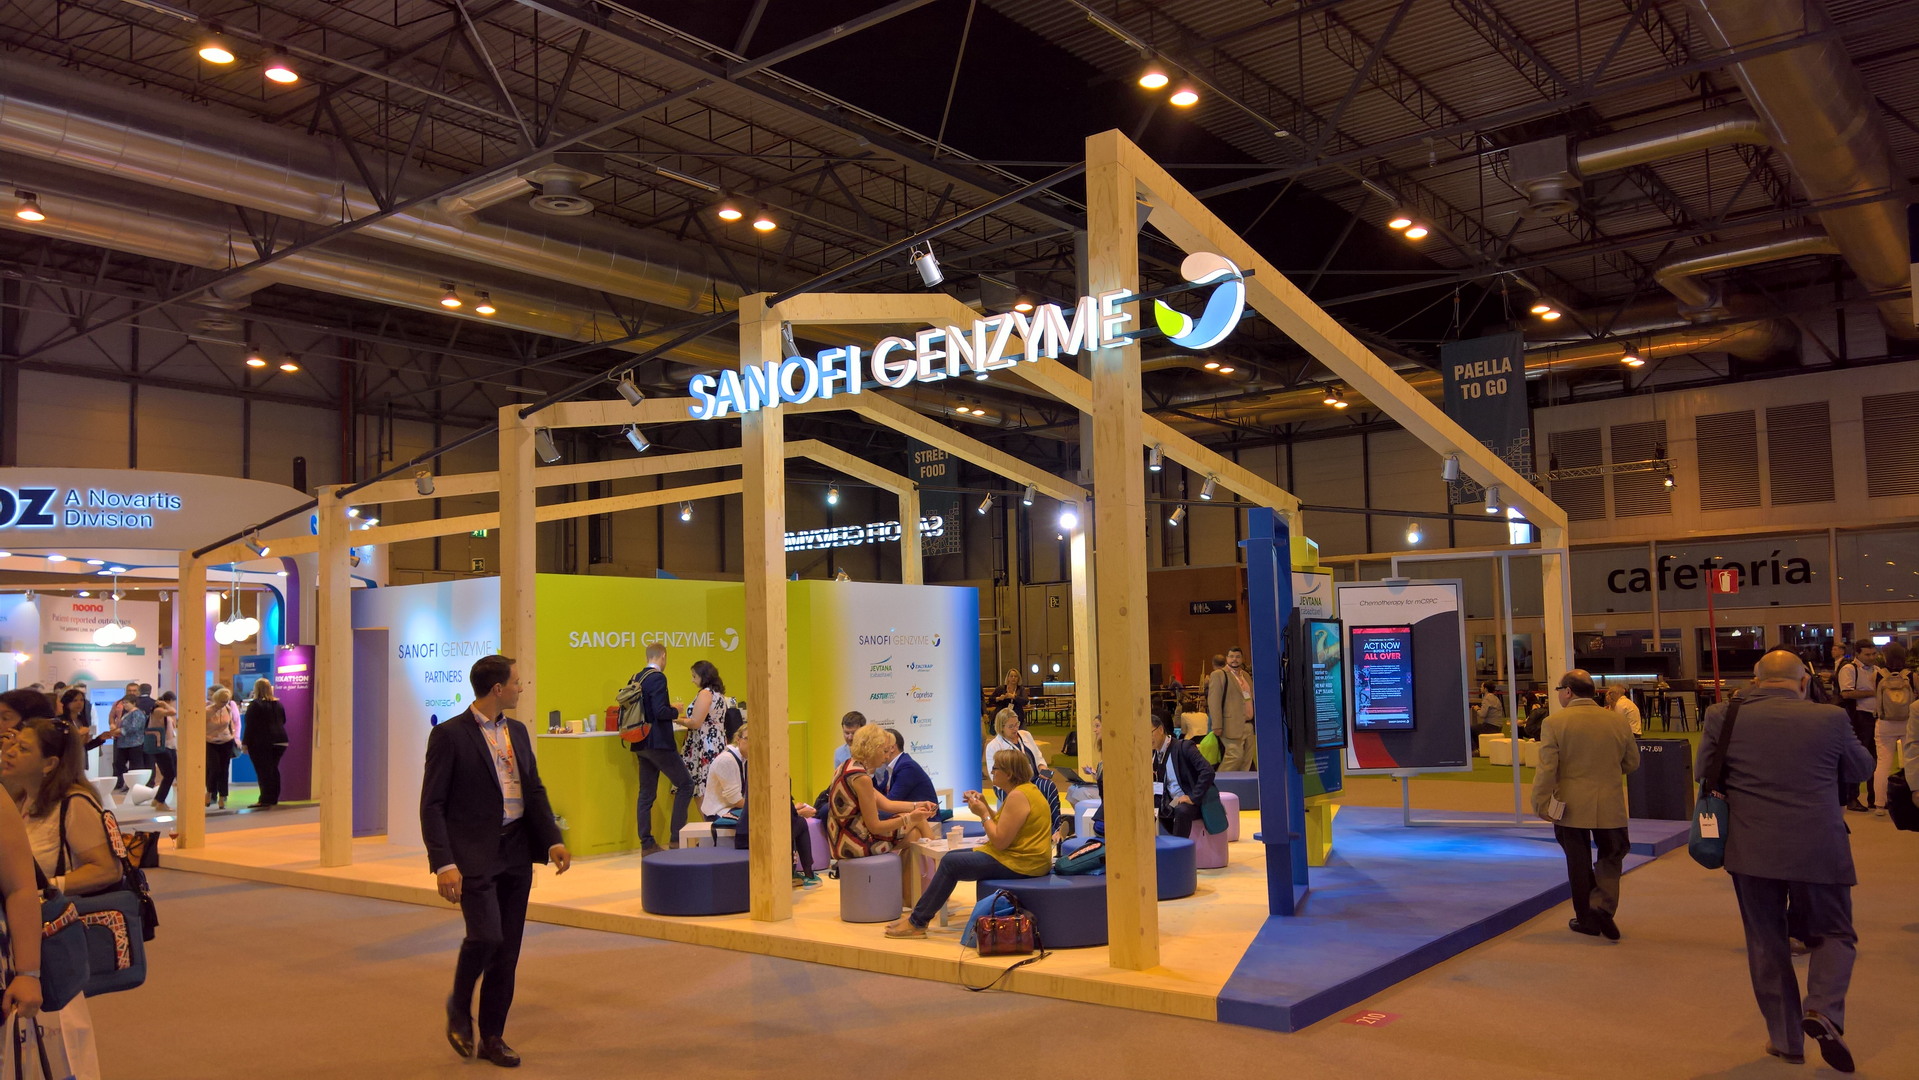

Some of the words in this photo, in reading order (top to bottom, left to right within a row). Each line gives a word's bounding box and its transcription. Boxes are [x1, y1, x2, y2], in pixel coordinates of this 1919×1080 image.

[688, 345, 862, 420] SANOFI
[871, 288, 1133, 388] GENZYME
[1454, 357, 1512, 380] PAELLA
[1461, 382, 1481, 400] TO
[1486, 378, 1507, 396] GO
[915, 449, 949, 464] STREET
[920, 463, 946, 478] FOOD
[65, 489, 80, 505] A
[89, 489, 181, 509] Novartis
[65, 509, 153, 527] Division
[72, 603, 103, 612] noona
[1360, 599, 1404, 607] Chemotherapy
[569, 631, 635, 648] SANOFI
[641, 632, 715, 648] GENZYME
[859, 635, 891, 646] SANOFI
[893, 635, 929, 646] GENZYME
[1363, 642, 1379, 650] ACT
[1381, 641, 1401, 650] NOW
[398, 643, 438, 659] SANOFI
[441, 640, 492, 657] GENZYME
[1380, 652, 1401, 660] OVER
[424, 670, 463, 683] PARTNERS
